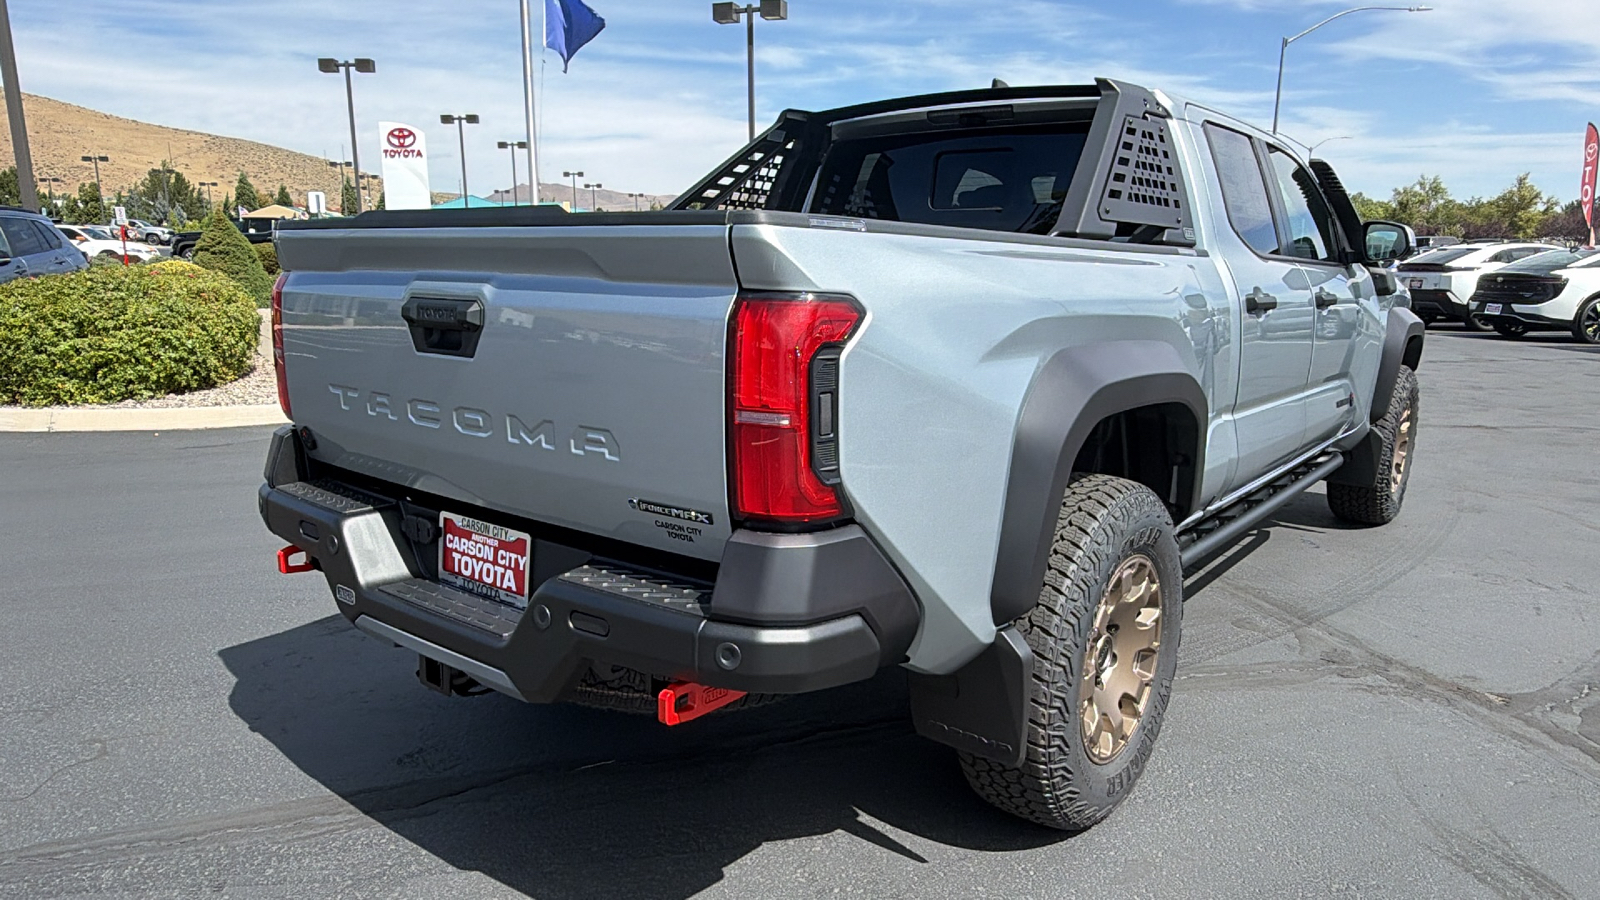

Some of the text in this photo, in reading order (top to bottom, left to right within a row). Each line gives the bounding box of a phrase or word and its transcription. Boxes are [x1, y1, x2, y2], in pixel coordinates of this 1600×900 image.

[383, 149, 423, 158] TOYOTA
[420, 307, 457, 320] TOYOTA
[328, 383, 620, 462] TACOMA
[461, 517, 509, 540] CARSON CITY
[654, 520, 702, 536] CARSON CITY
[666, 530, 694, 543] TOYOTA
[471, 533, 499, 547] ANOTHER
[446, 534, 527, 571] CARSON CITY
[452, 552, 517, 592] TOYOTA
[461, 578, 501, 600] TOYOTA
